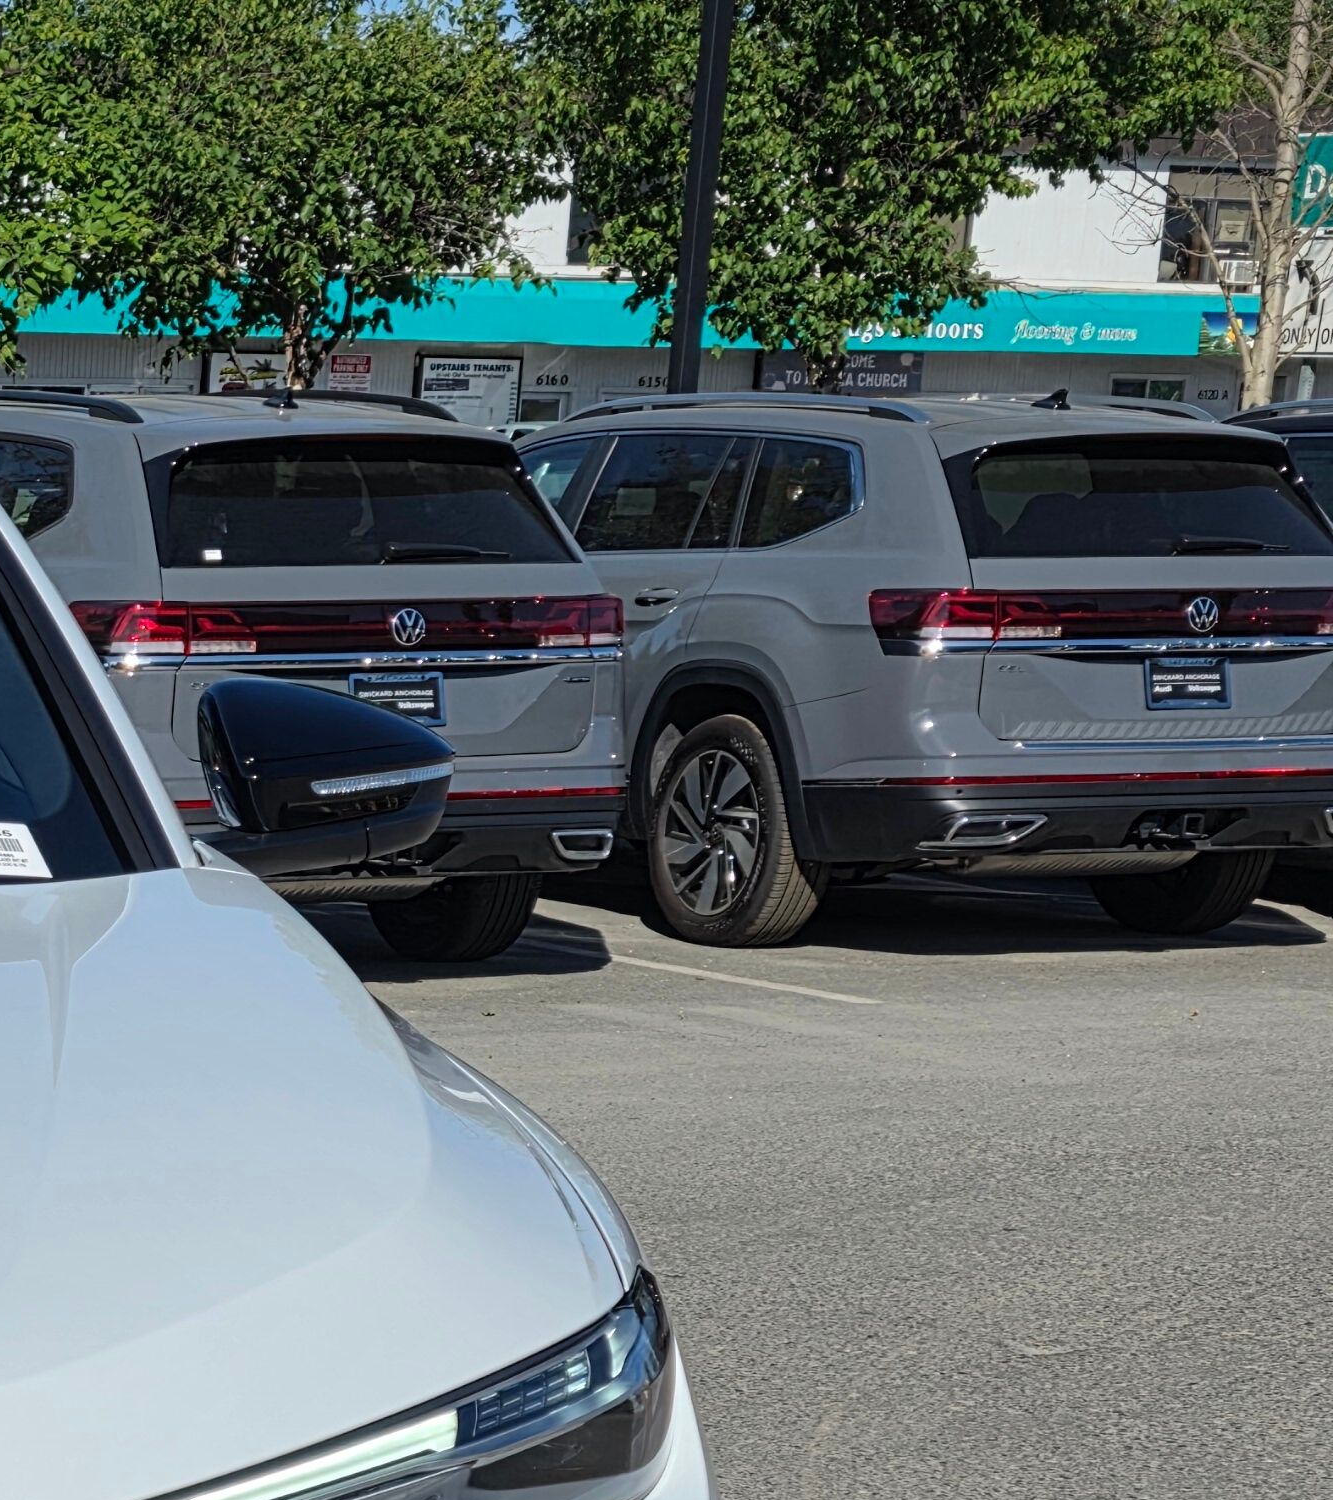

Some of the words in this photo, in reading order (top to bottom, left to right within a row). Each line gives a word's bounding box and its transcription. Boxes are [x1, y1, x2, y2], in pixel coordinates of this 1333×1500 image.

[1010, 319, 1078, 345] flooring
[1079, 322, 1096, 341] &
[1097, 327, 1138, 341] more
[1283, 327, 1317, 345] ONLY
[430, 363, 471, 372] UPSTAIRS
[473, 364, 514, 372] TENANTS:
[536, 374, 569, 386] 6160
[786, 370, 802, 385] TO
[857, 372, 908, 388] CHURCH
[1197, 389, 1219, 400] 6120
[1221, 389, 1229, 400] A
[394, 689, 434, 697] ANCHORAGE
